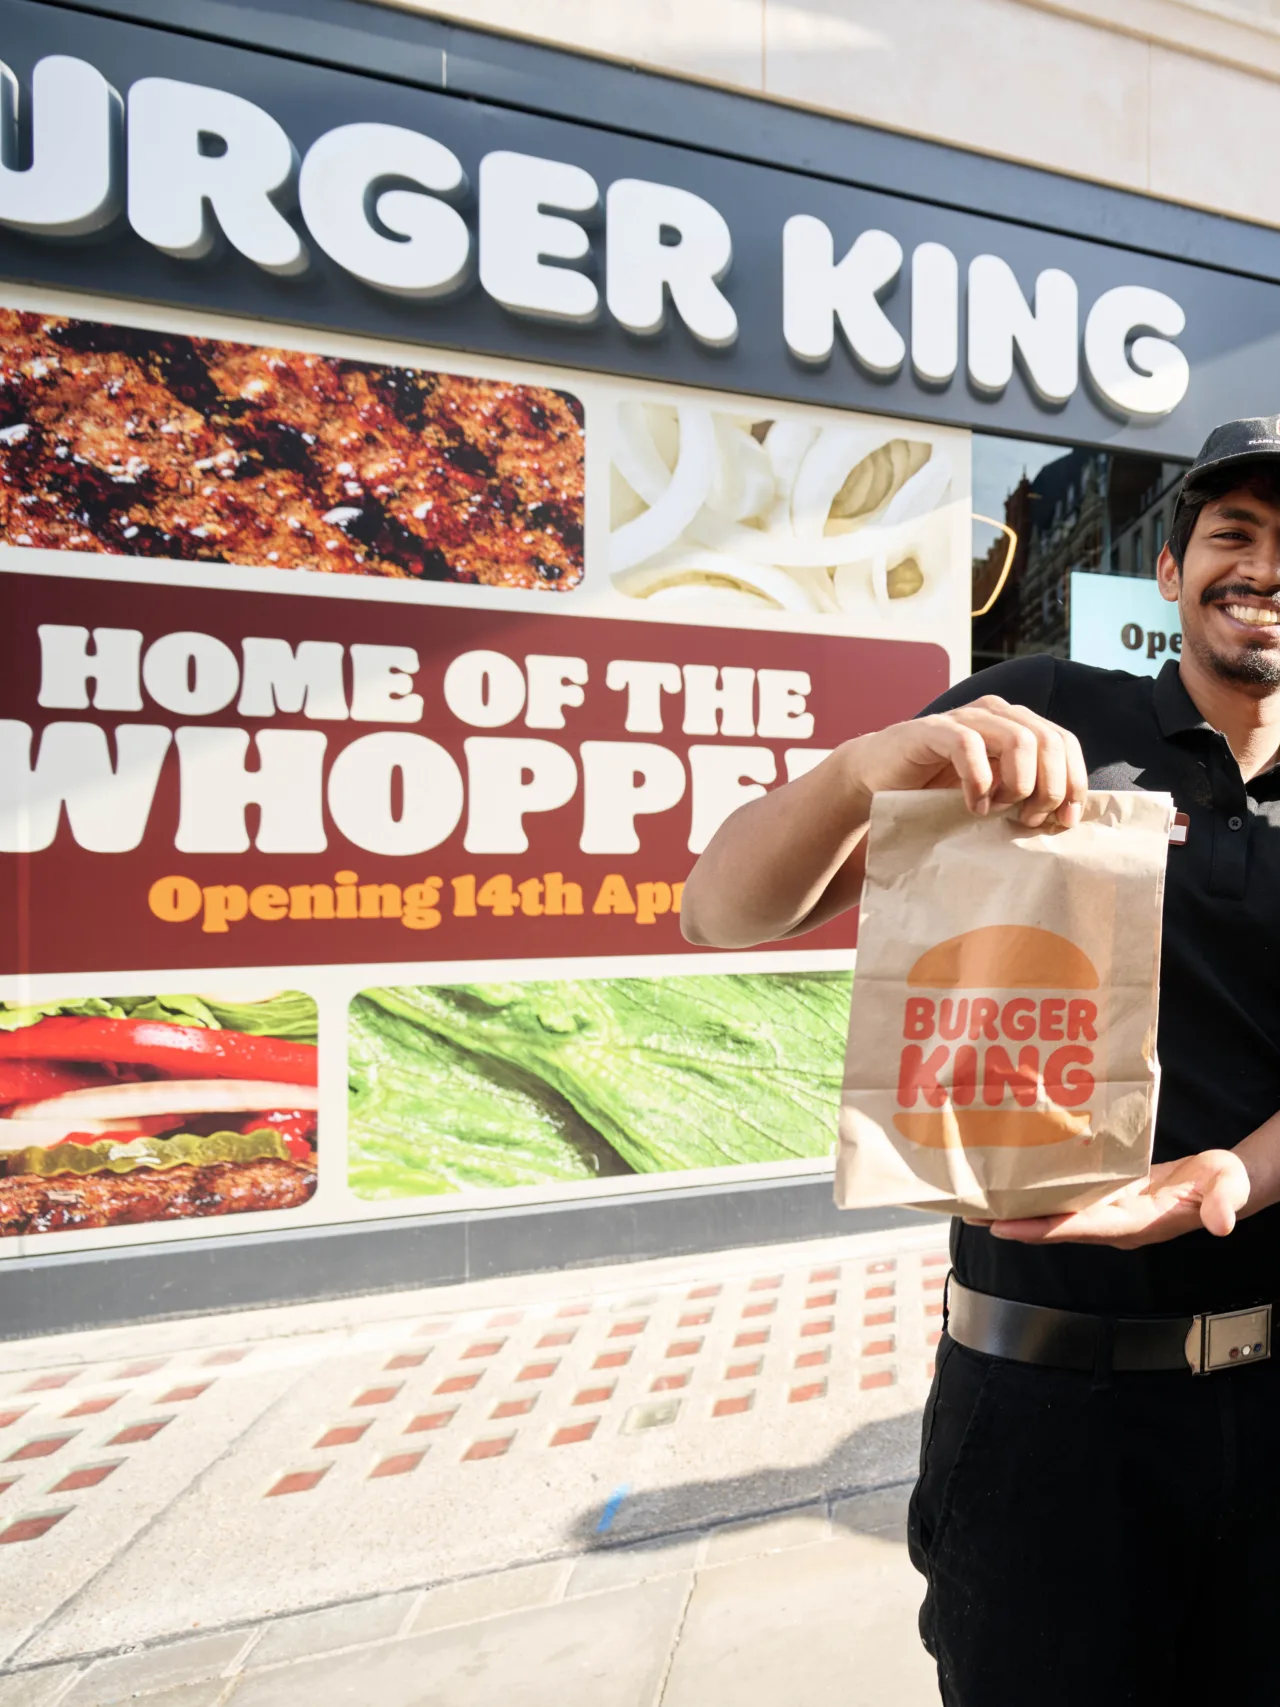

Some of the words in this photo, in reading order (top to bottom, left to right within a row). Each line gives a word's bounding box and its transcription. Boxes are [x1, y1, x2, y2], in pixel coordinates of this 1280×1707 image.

[782, 213, 1190, 414] KING
[1121, 622, 1182, 659] Ope
[37, 624, 424, 723] HOME
[444, 650, 589, 729] OF
[606, 661, 815, 739] THE
[0, 718, 836, 857] WHOPPE
[148, 870, 444, 933] Opening
[451, 872, 585, 917] 14th
[903, 997, 1098, 1042] BURGER
[897, 1044, 1095, 1109] KING
